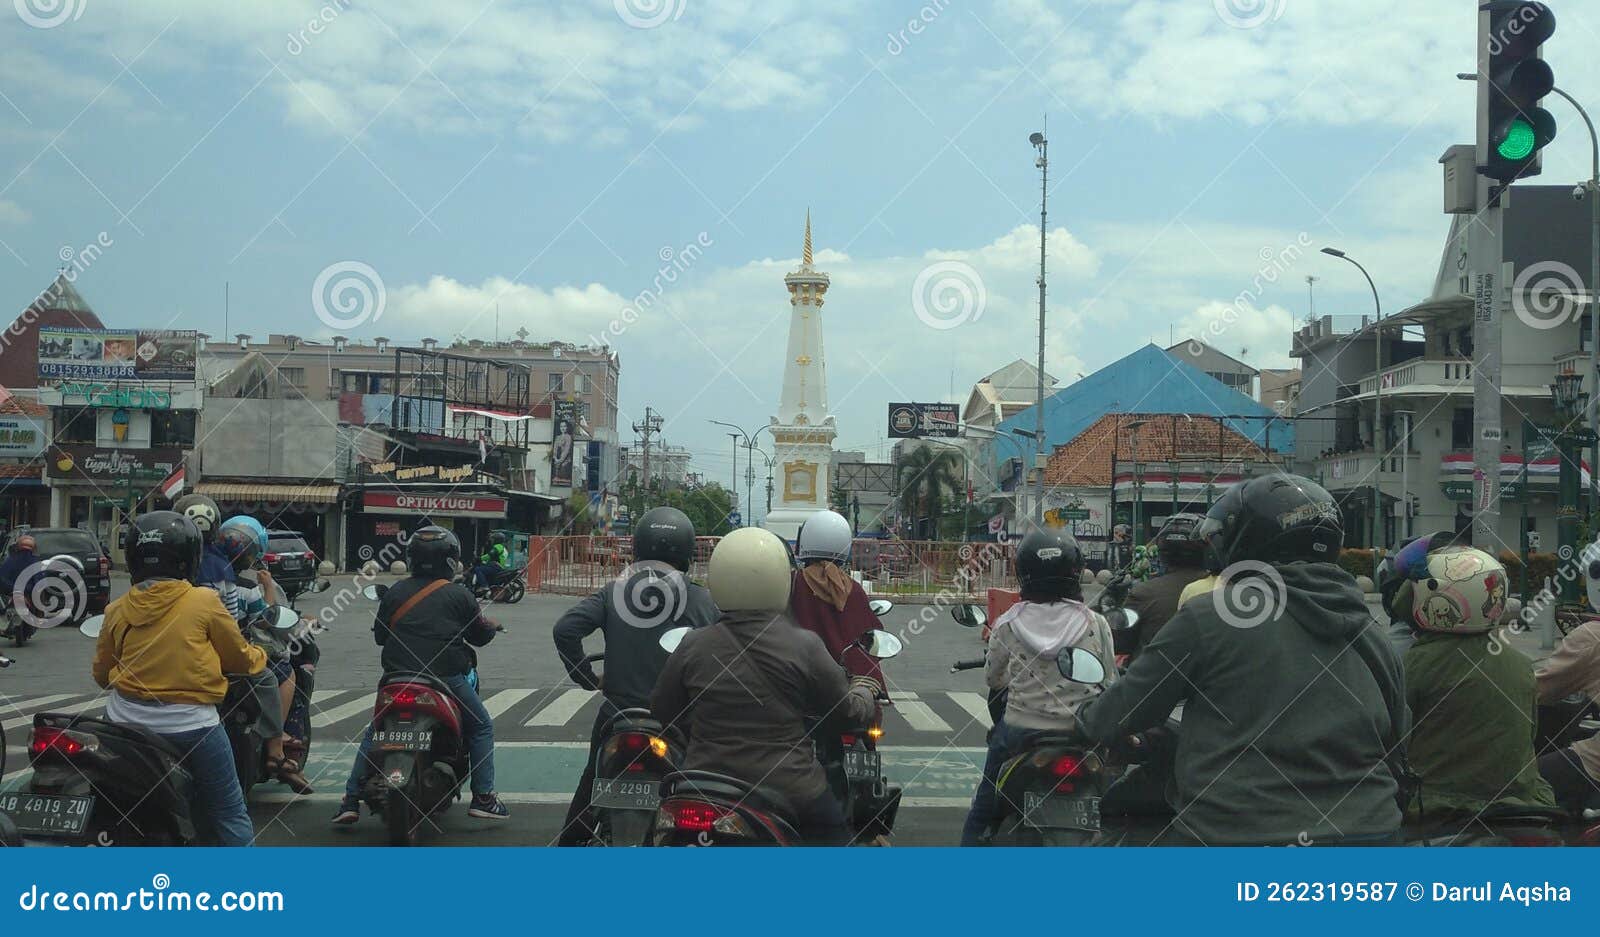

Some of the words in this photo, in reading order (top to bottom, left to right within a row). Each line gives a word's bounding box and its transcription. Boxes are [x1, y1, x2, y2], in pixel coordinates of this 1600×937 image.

[396, 496, 437, 508] OPTIK
[437, 498, 476, 510] TUGU
[372, 731, 385, 742] AB
[389, 731, 414, 742] 6999
[597, 780, 612, 793] AA
[620, 783, 651, 795] 2290
[0, 796, 17, 811] AB
[25, 797, 61, 813] 4819
[67, 799, 86, 815] ZU
